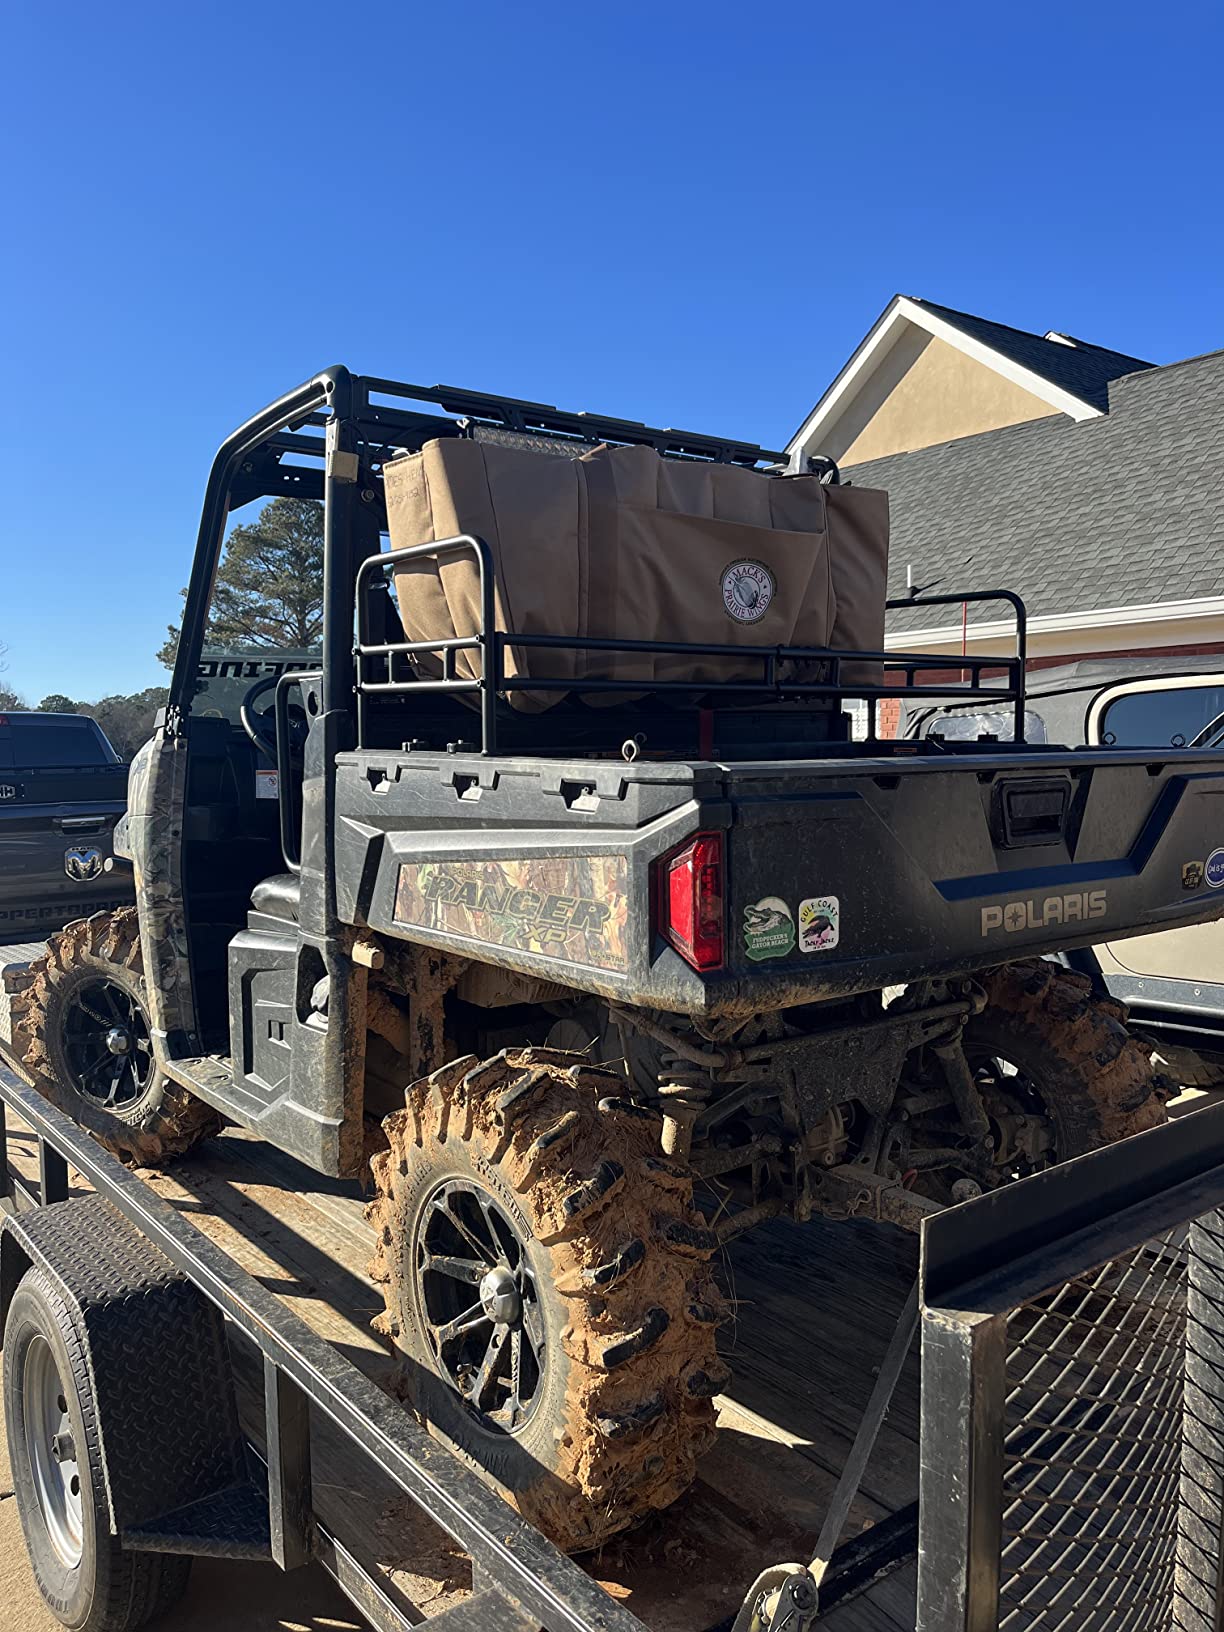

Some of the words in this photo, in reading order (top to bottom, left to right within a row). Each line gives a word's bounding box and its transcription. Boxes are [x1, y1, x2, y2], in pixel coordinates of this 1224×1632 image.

[732, 567, 766, 584] MACK'S
[725, 589, 746, 618] PRAIRIE
[747, 593, 769, 617] WINGS
[424, 875, 612, 935] RANGER
[800, 902, 815, 922] GULF
[818, 900, 838, 917] COAST
[981, 890, 1107, 937] POLARIS
[519, 923, 567, 943] XP
